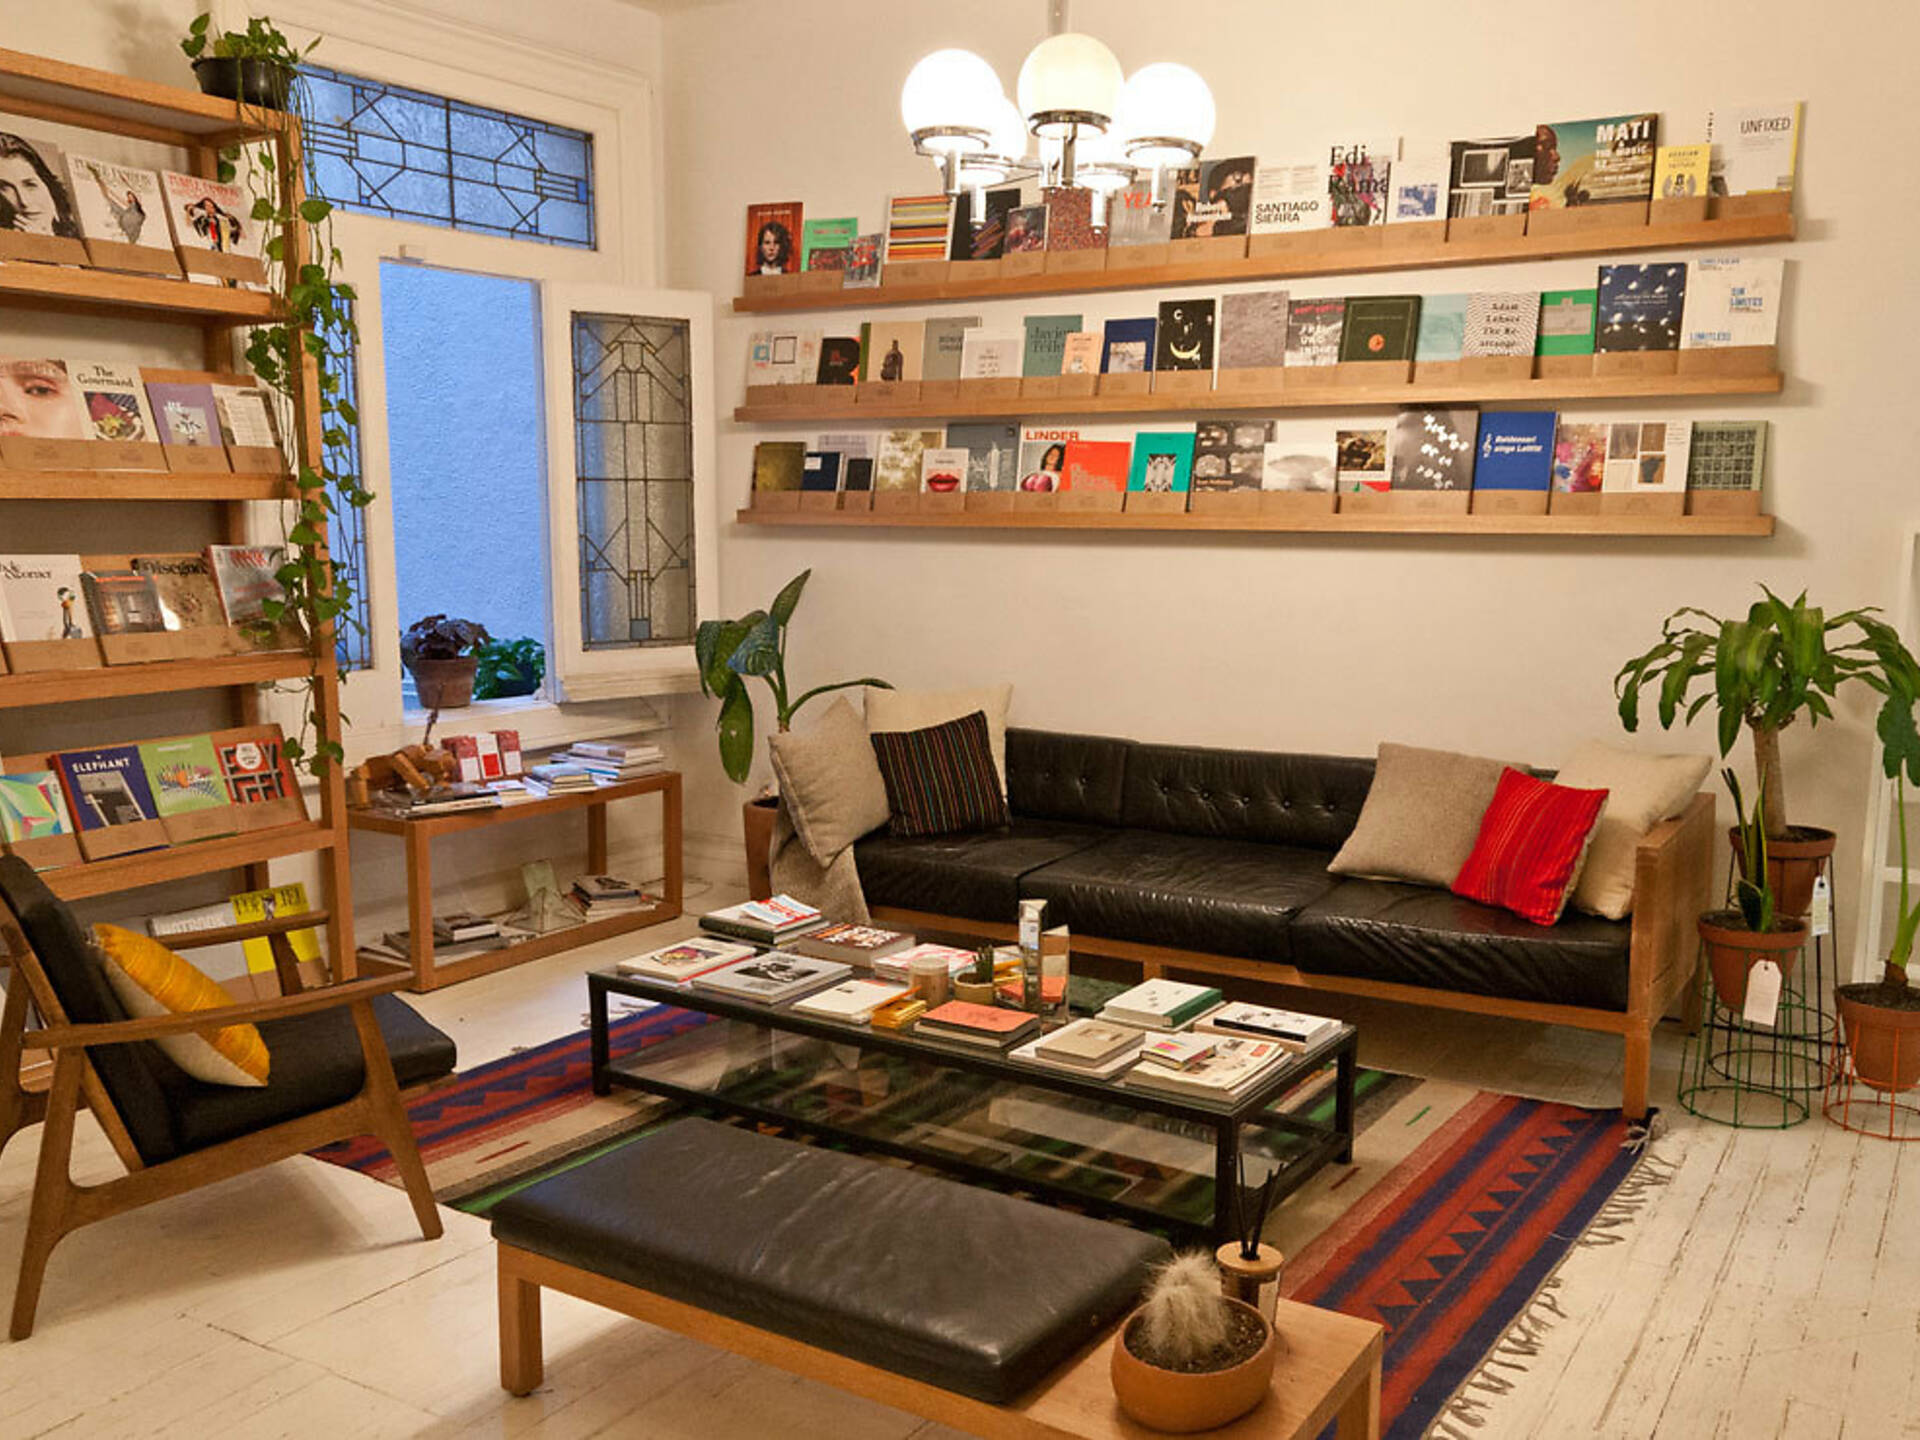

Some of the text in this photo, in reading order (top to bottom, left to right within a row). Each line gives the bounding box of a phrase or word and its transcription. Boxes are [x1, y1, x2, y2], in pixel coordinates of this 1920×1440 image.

[1596, 120, 1650, 143] MATI
[1740, 117, 1791, 134] UNFIXED
[1330, 145, 1366, 166] Edi
[1328, 175, 1389, 194] Rama
[1255, 201, 1319, 215] SANTIAGO
[1255, 213, 1301, 225] SIERRA
[92, 365, 113, 377] The
[76, 373, 134, 388] Gourmand
[1026, 430, 1079, 441] LINDER
[71, 757, 130, 774] ELEPHANT
